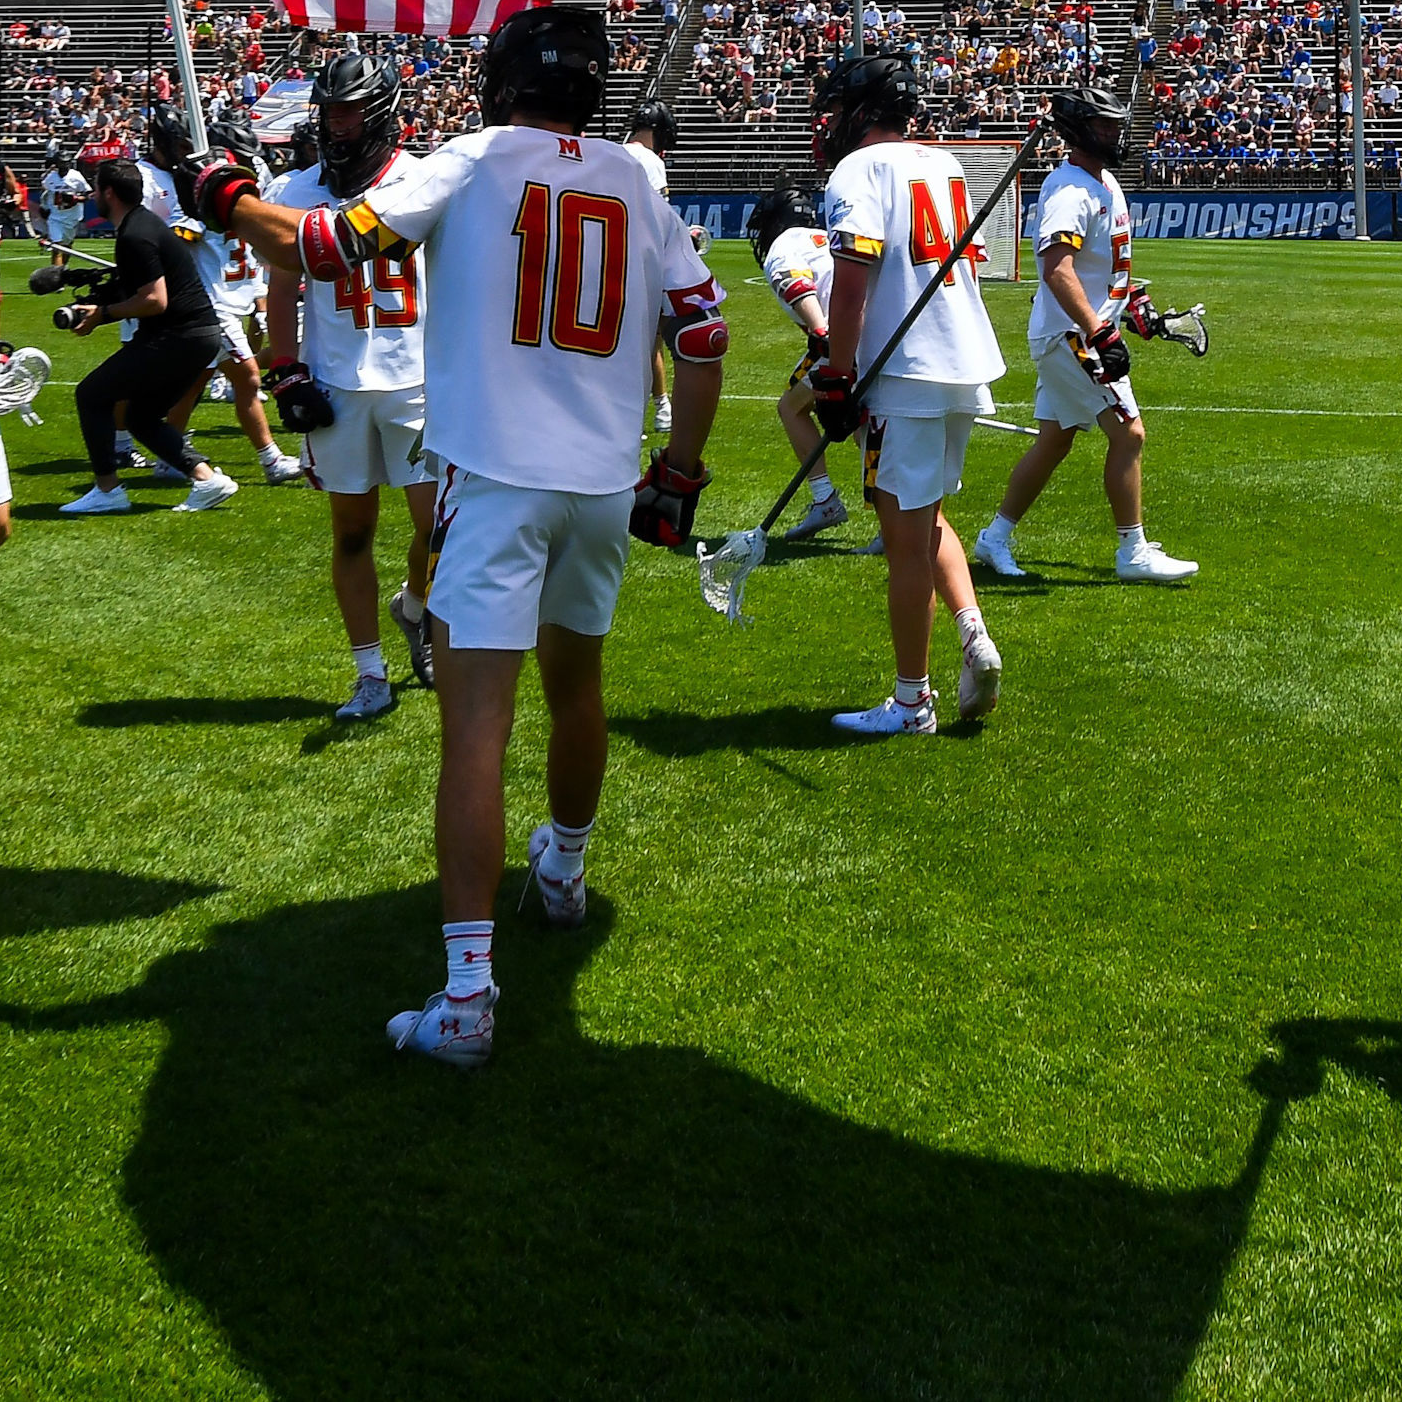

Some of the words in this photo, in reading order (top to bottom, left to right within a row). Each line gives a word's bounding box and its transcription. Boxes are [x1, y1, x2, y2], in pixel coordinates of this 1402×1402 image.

[541, 50, 558, 64] RM
[556, 137, 582, 160] M
[510, 179, 629, 358] 10
[908, 177, 978, 286] 44
[335, 254, 418, 329] 49
